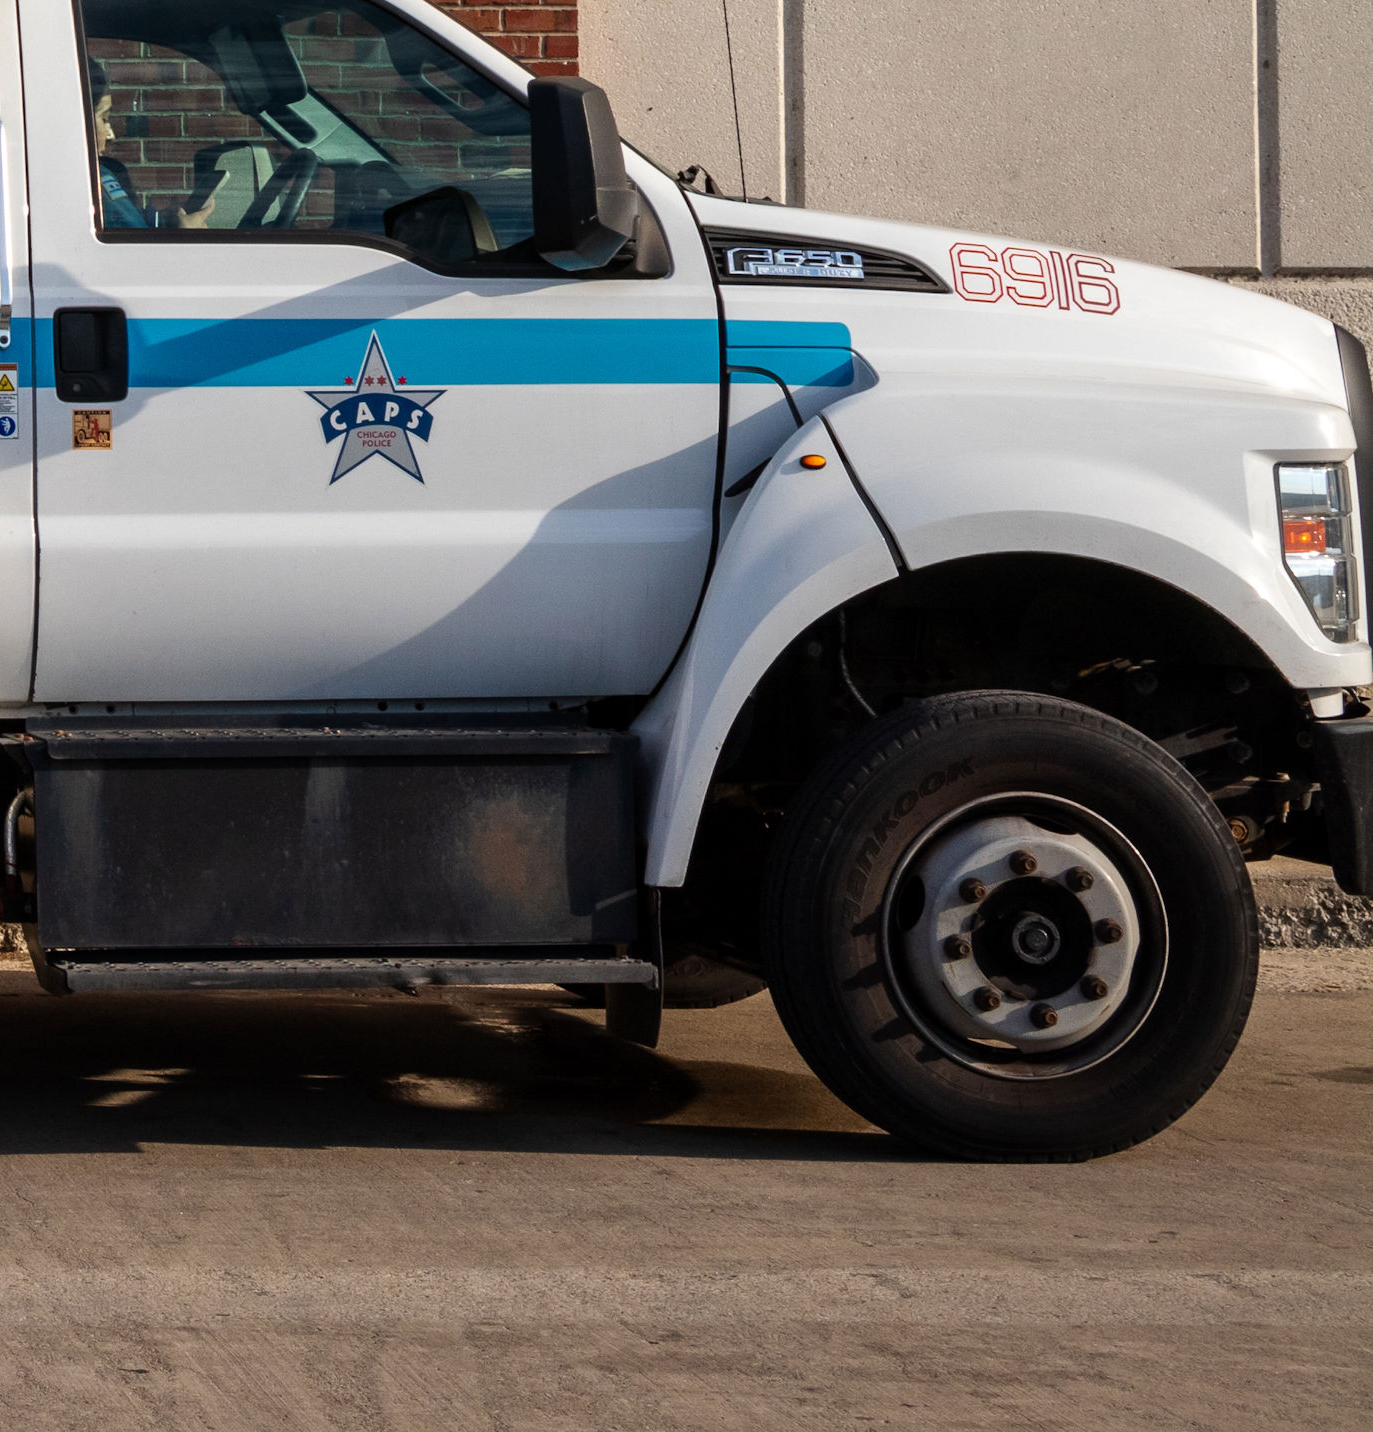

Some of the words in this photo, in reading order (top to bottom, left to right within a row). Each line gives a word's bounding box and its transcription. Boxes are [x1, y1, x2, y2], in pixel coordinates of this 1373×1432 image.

[950, 242, 1120, 315] 6916
[329, 401, 424, 431] CAPS
[356, 431, 397, 439] CHICAGO
[362, 439, 392, 448] POLICE
